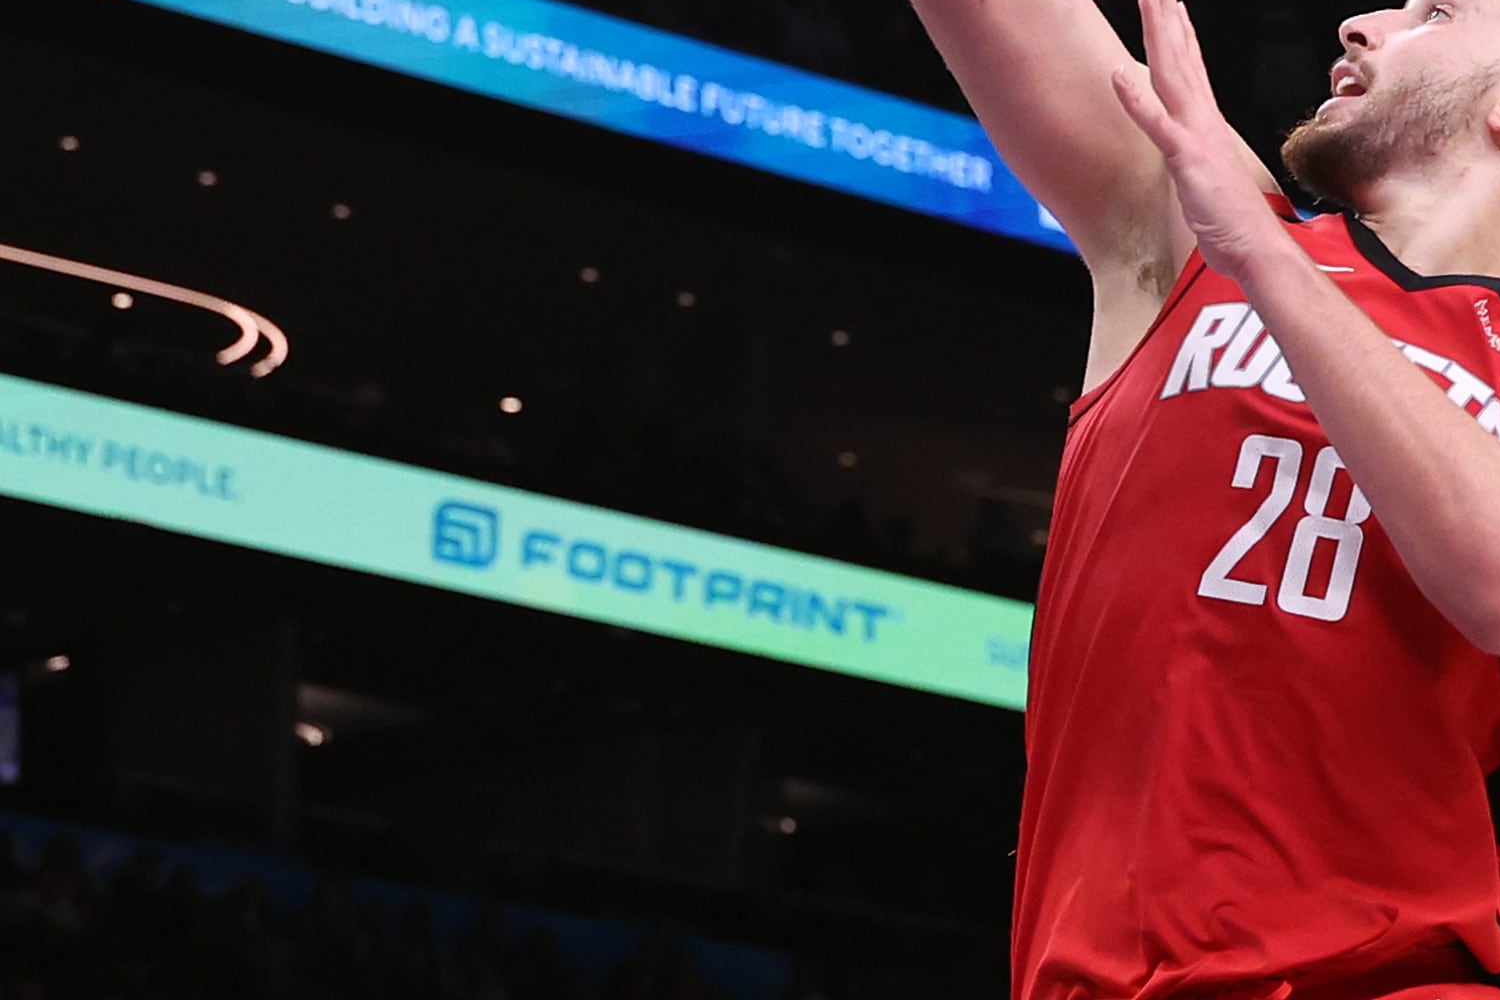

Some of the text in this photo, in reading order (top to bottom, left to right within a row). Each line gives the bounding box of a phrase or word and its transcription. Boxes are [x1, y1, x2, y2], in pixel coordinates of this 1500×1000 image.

[453, 15, 482, 51] A
[483, 20, 697, 113] SUSTAINABLE
[701, 81, 827, 149] FUTURE
[830, 116, 992, 192] TOGETHER
[521, 530, 890, 643] FOOTPRINT
[1197, 434, 1372, 622] 28
